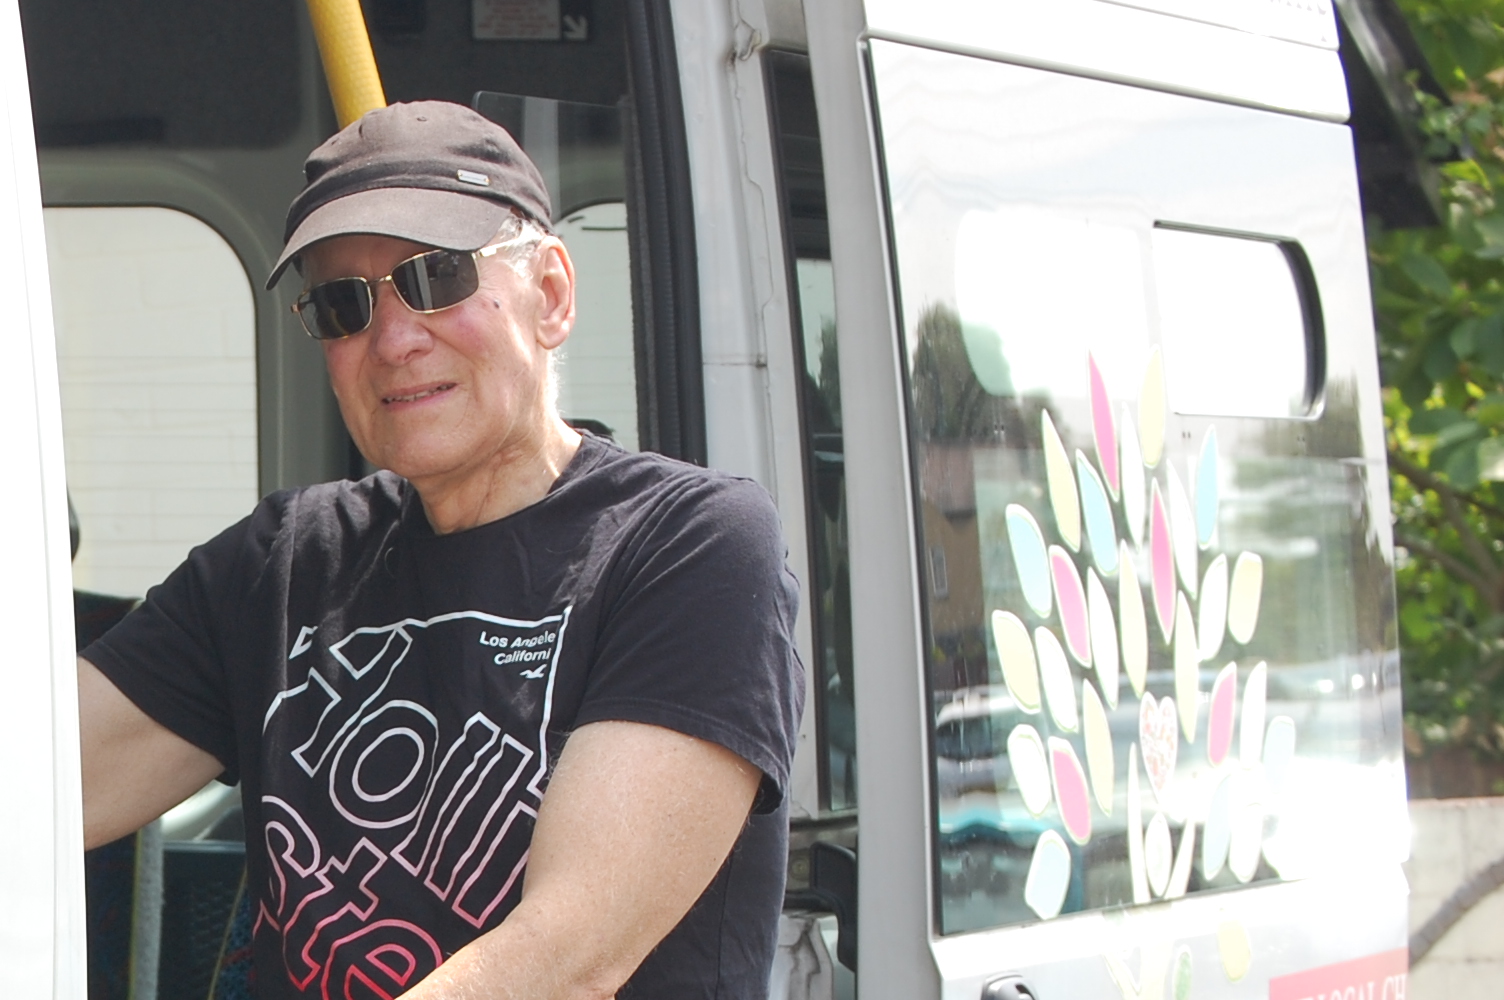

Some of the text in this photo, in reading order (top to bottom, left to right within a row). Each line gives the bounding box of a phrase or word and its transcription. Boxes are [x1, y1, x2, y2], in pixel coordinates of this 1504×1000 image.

[479, 631, 557, 649] Los Angele
[493, 647, 552, 665] Californi
